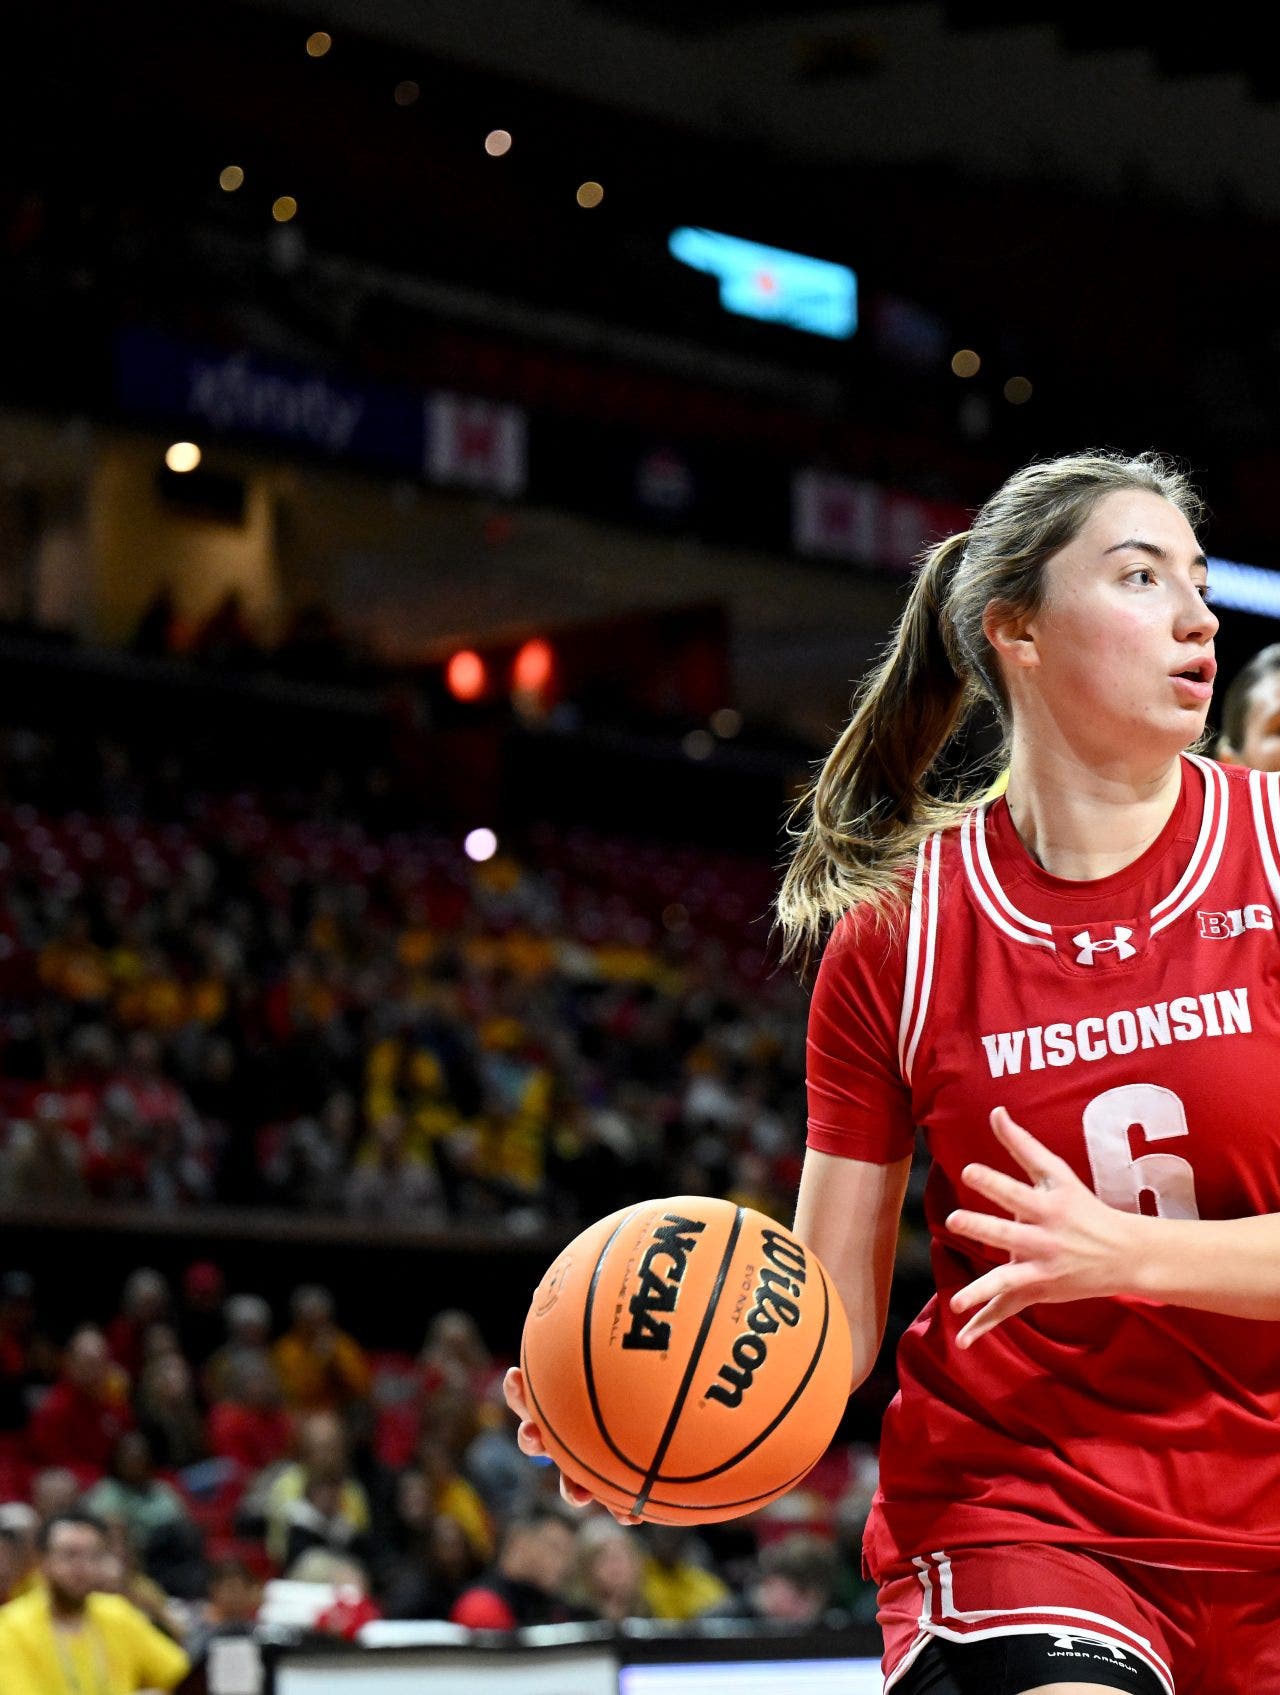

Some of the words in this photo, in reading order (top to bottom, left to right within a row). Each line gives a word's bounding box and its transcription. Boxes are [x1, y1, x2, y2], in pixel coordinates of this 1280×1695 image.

[981, 987, 1253, 1079] WISCONSIN
[1082, 1083, 1199, 1221] 6
[622, 1213, 706, 1351] NCAA
[704, 1228, 808, 1410] Wilson
[731, 1292, 749, 1324] NXT
[742, 1263, 756, 1292] EVO
[1093, 1655, 1138, 1674] ARMOUR
